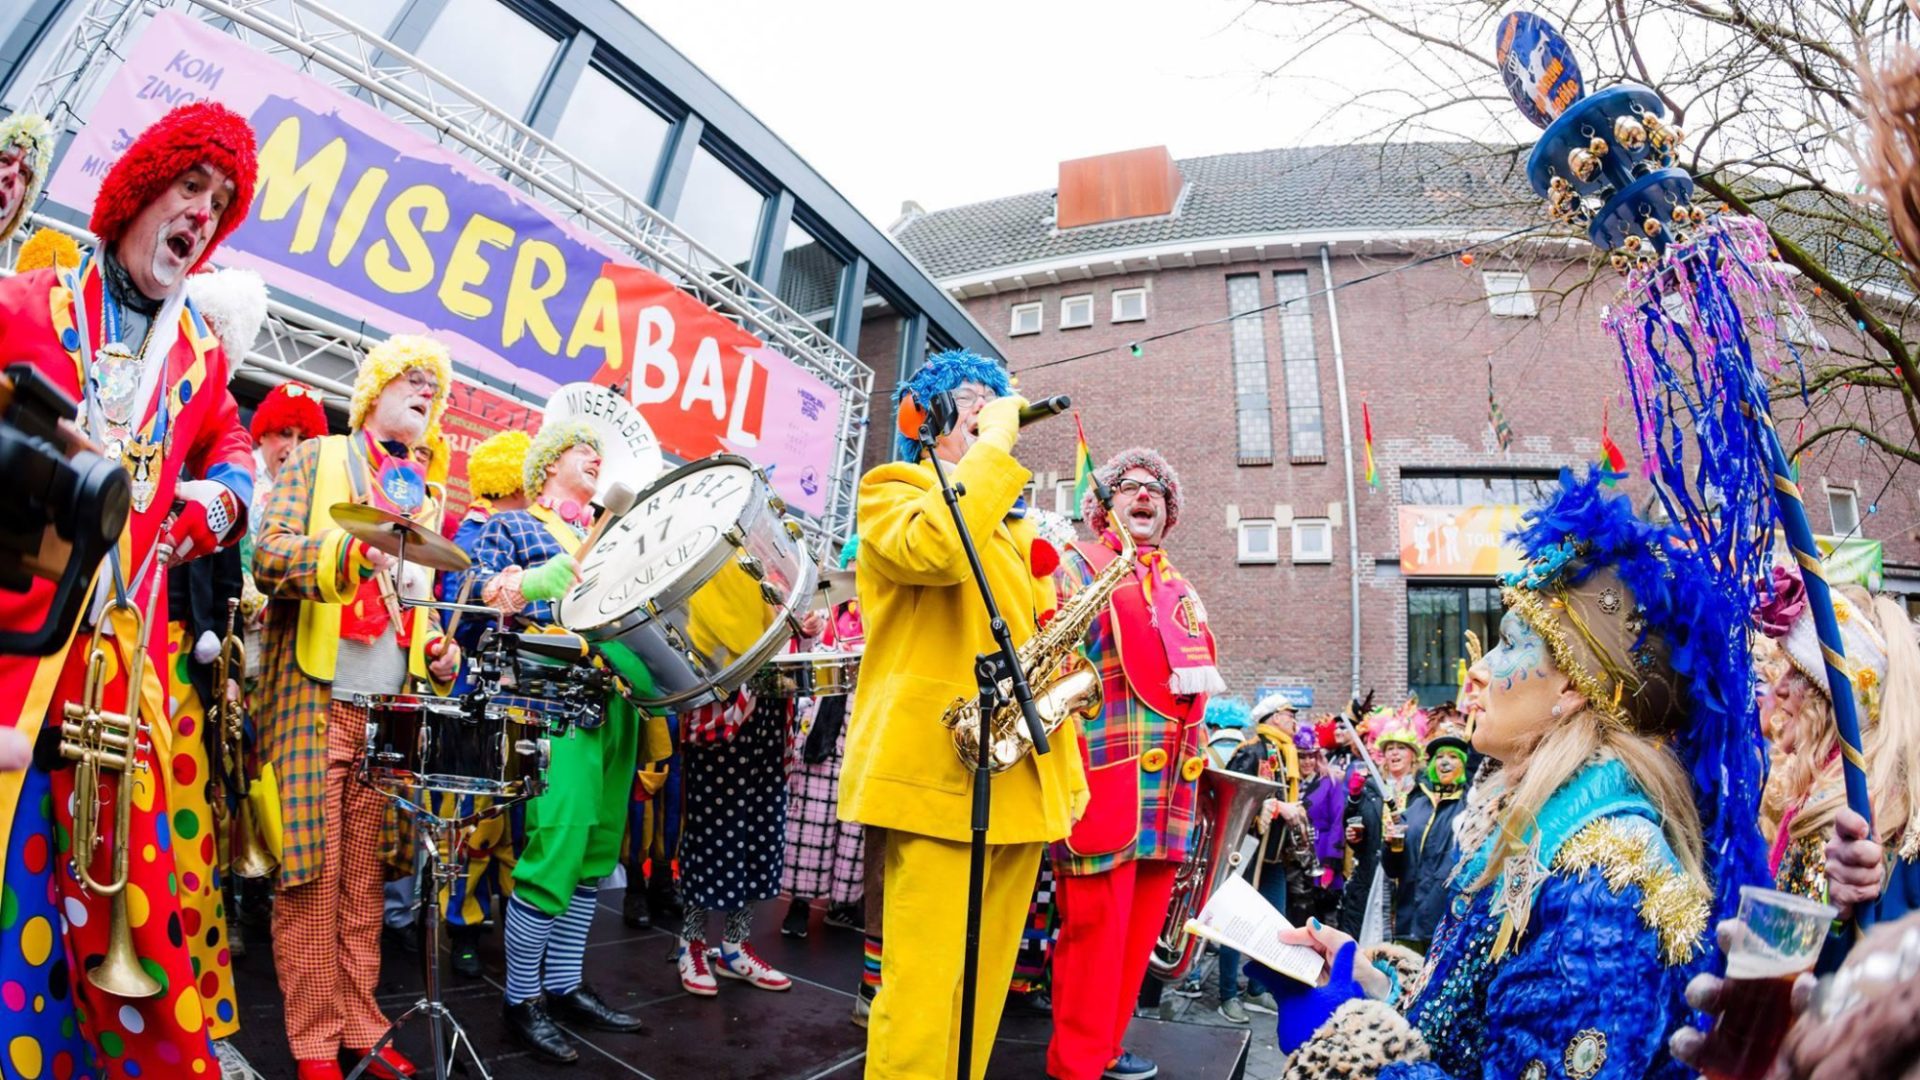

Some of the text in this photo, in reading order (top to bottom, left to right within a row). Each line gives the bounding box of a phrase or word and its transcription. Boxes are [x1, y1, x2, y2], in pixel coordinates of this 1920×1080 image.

[164, 49, 225, 91] KOM
[566, 390, 652, 458] MISERABEL
[572, 473, 743, 602] MISERABEL
[634, 515, 674, 557] 17
[1465, 532, 1503, 548] TOIL
